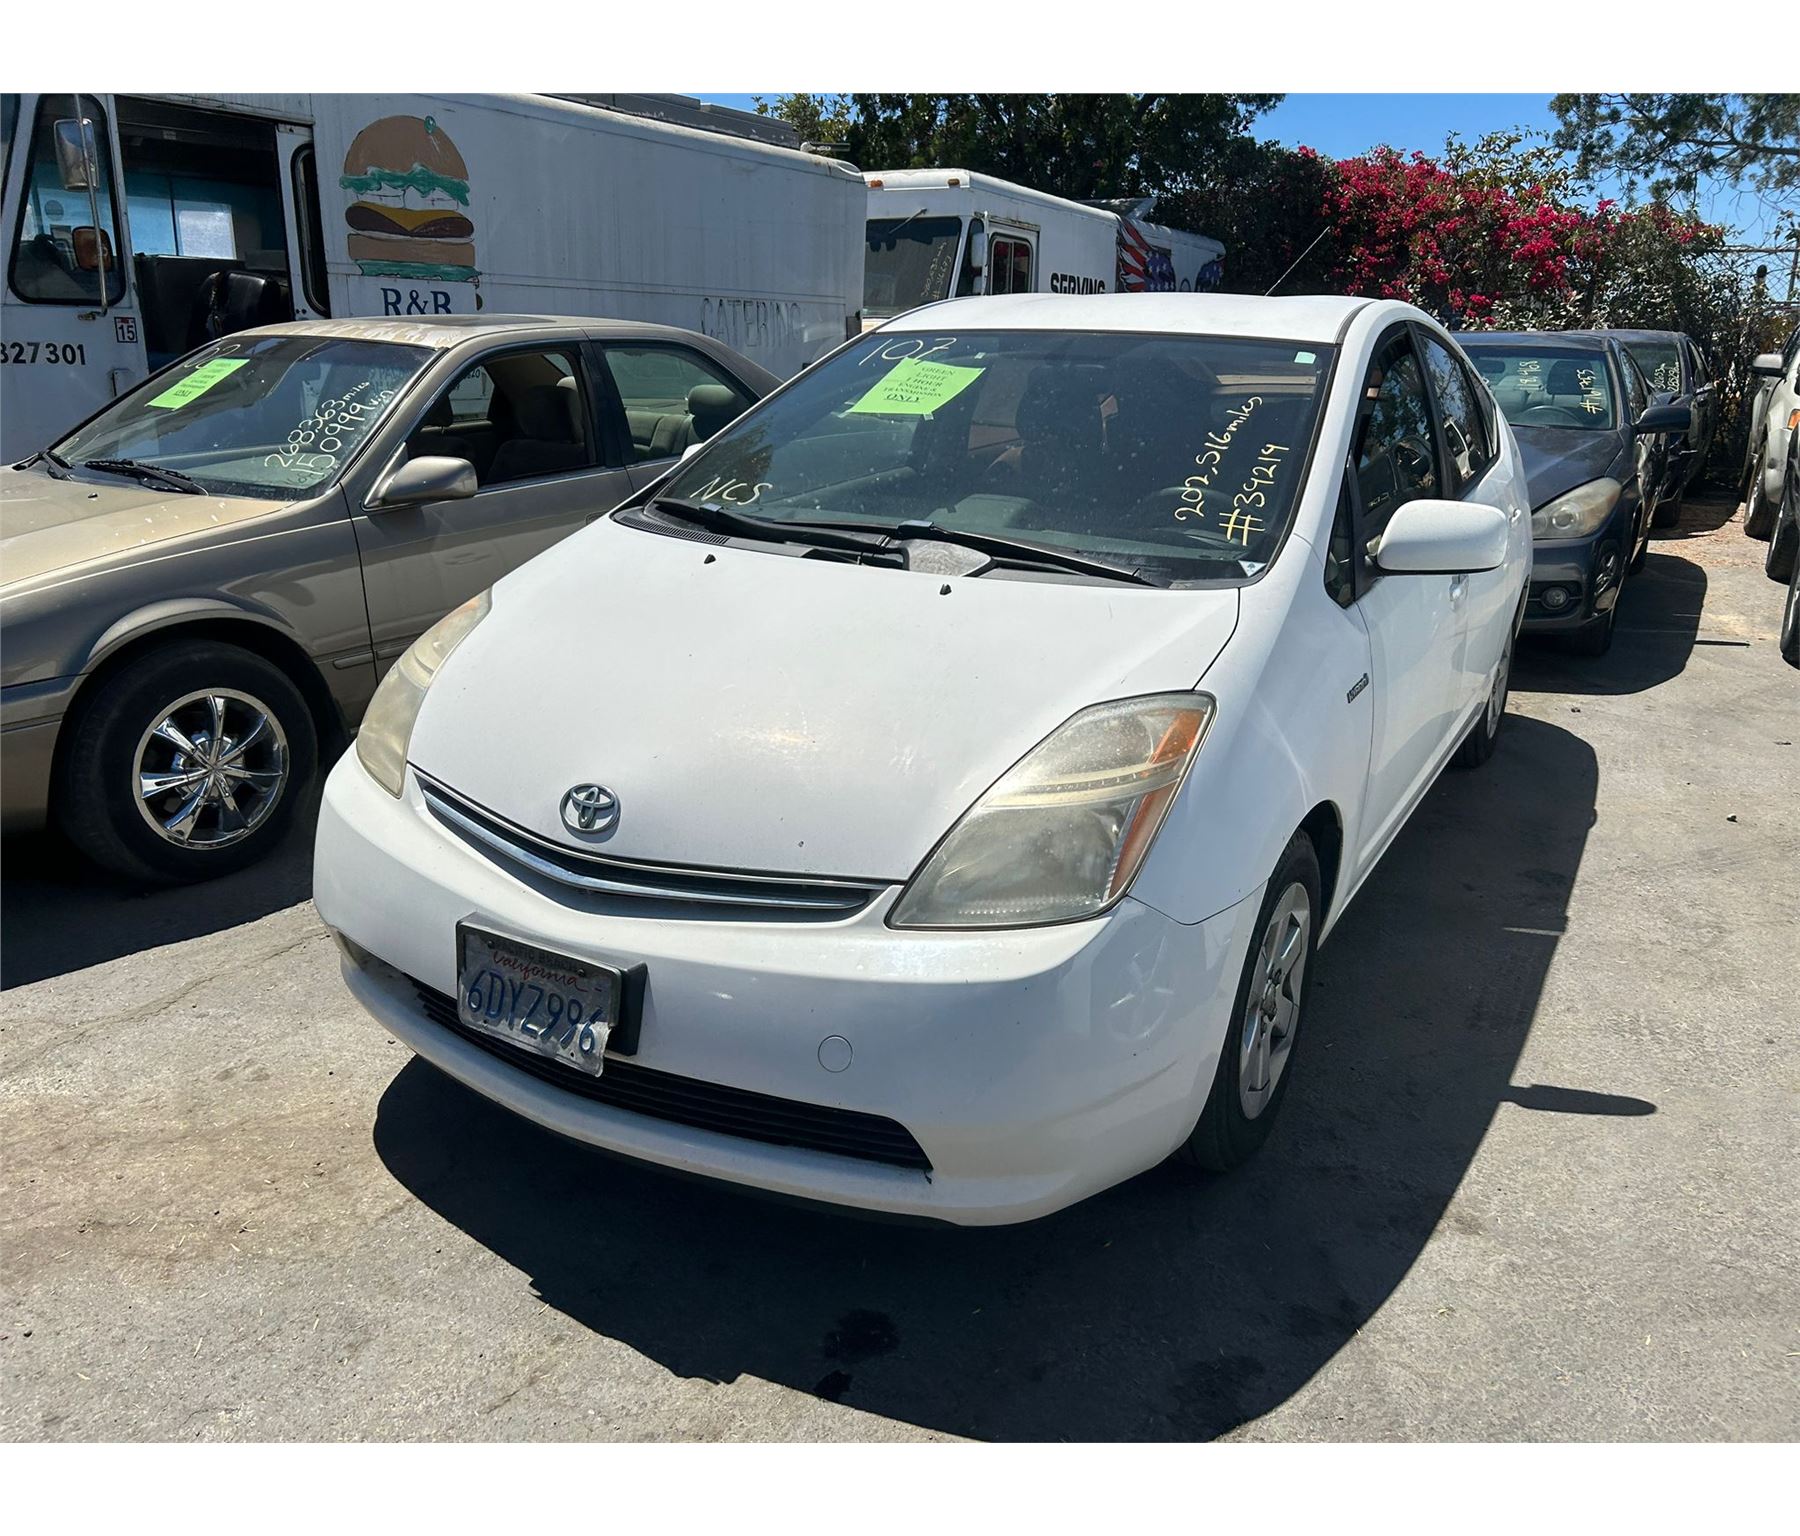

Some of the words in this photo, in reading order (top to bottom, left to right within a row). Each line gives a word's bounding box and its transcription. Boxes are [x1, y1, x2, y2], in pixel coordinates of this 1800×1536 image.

[381, 287, 452, 316] R&R
[118, 325, 135, 341] 15
[858, 337, 957, 365] 107
[884, 393, 922, 403] ONLY
[689, 477, 774, 505] NCS
[468, 969, 604, 1055] 6DYZ996
